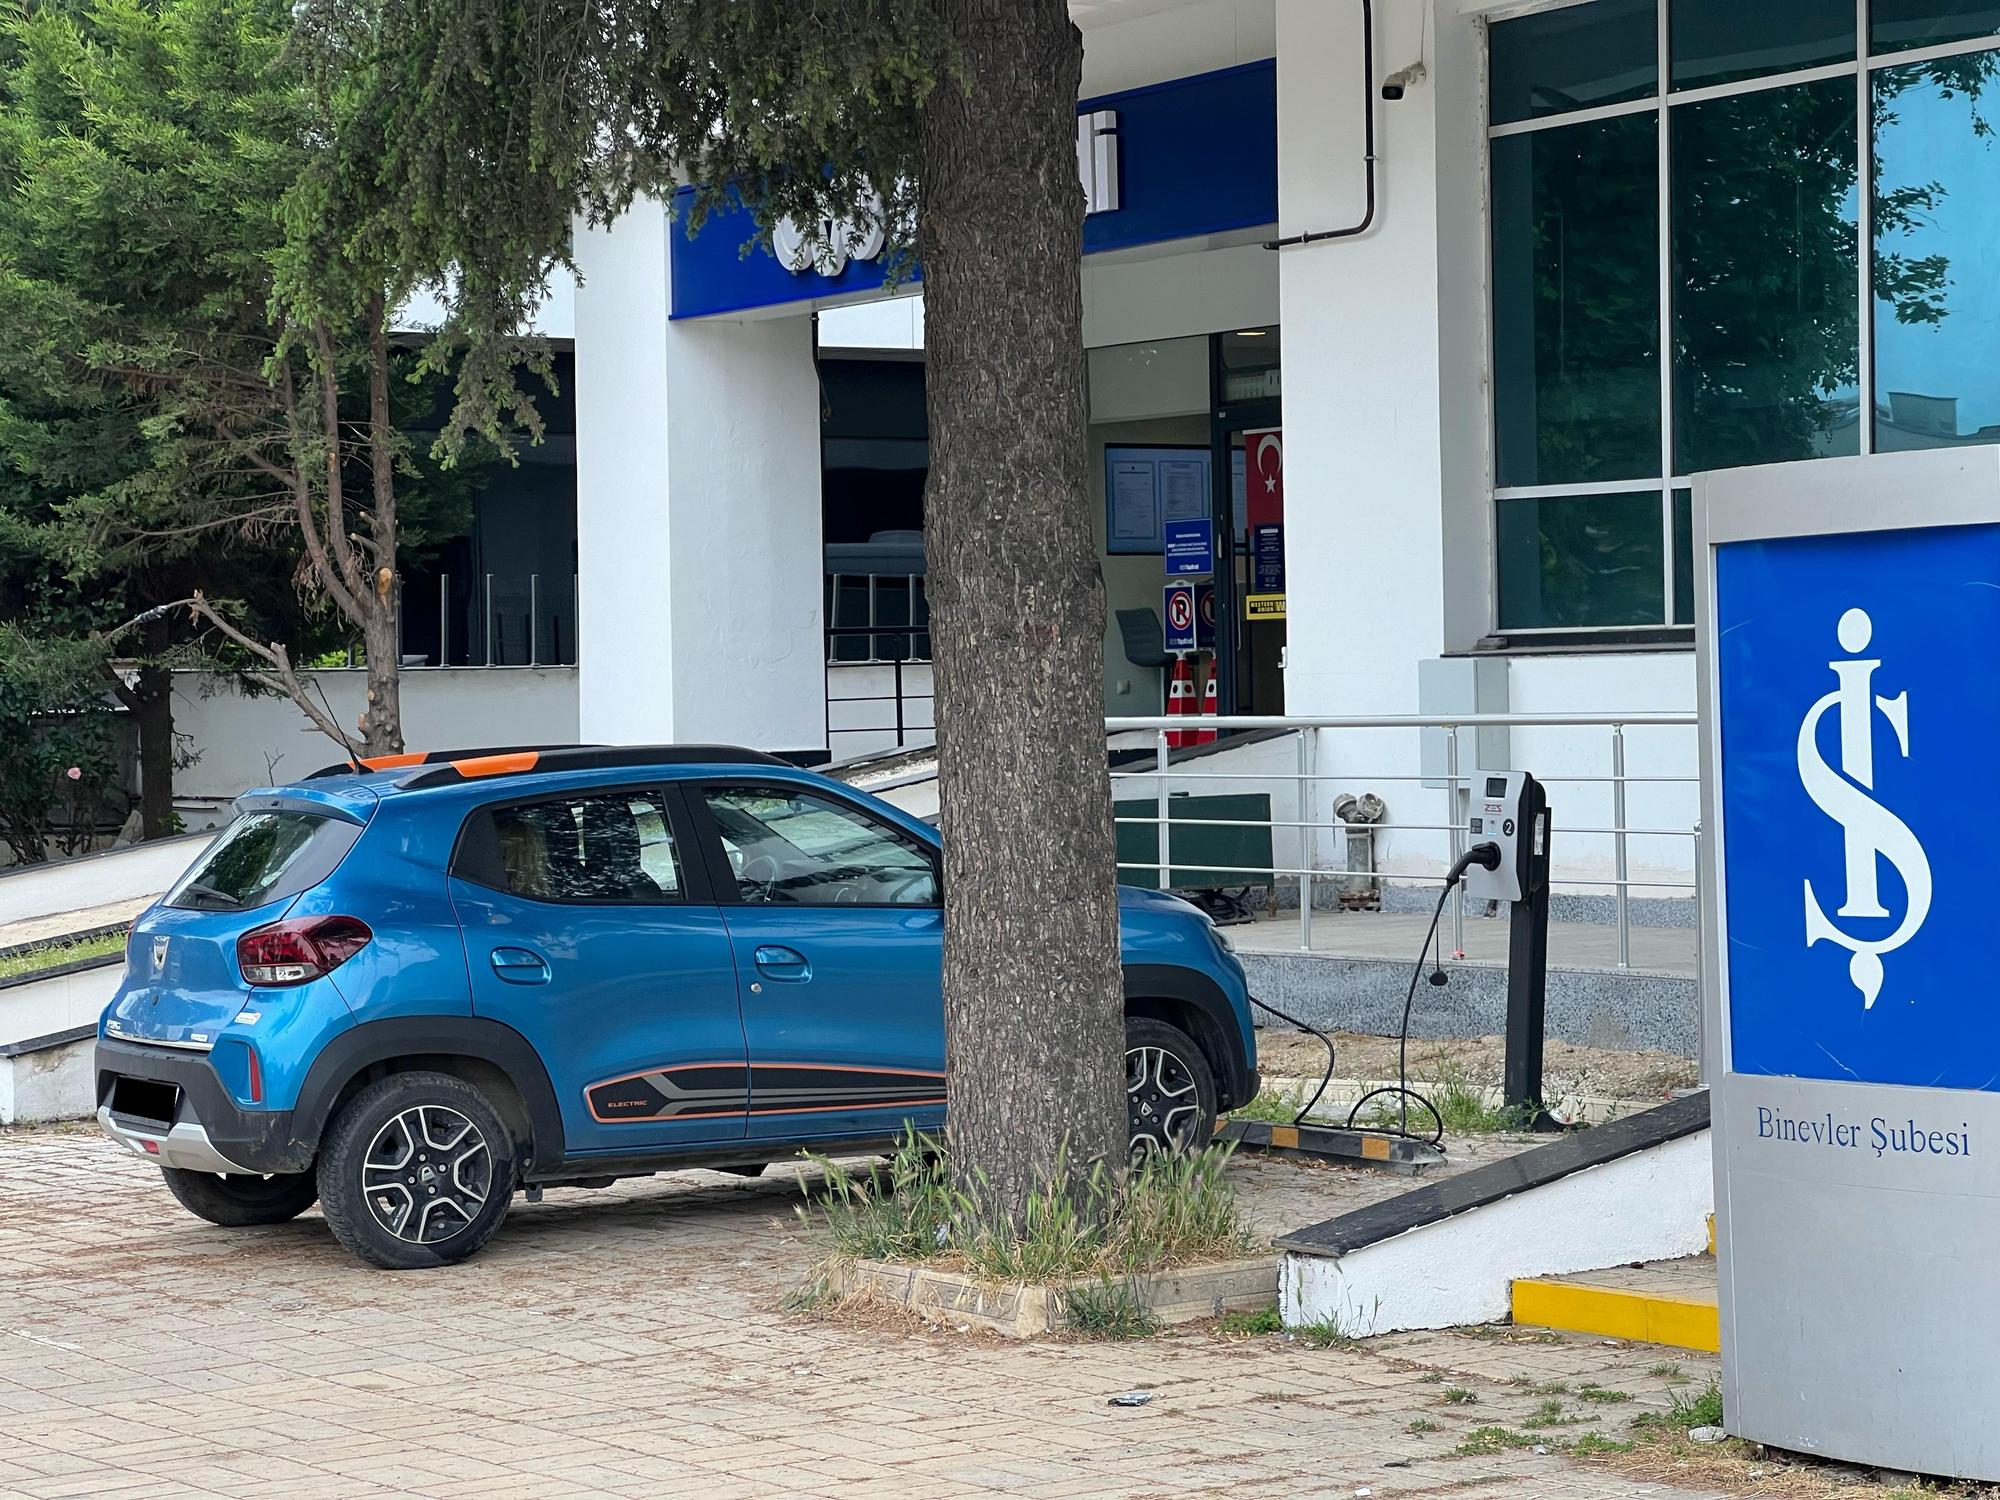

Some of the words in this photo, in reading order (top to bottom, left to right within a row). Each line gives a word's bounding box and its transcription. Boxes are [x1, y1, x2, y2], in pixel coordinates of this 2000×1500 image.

[1505, 821, 1512, 834] 2
[607, 1100, 647, 1108] ELECTRIC
[1757, 1106, 1861, 1148] Binevler
[1870, 1117, 1971, 1158] Şubesi
